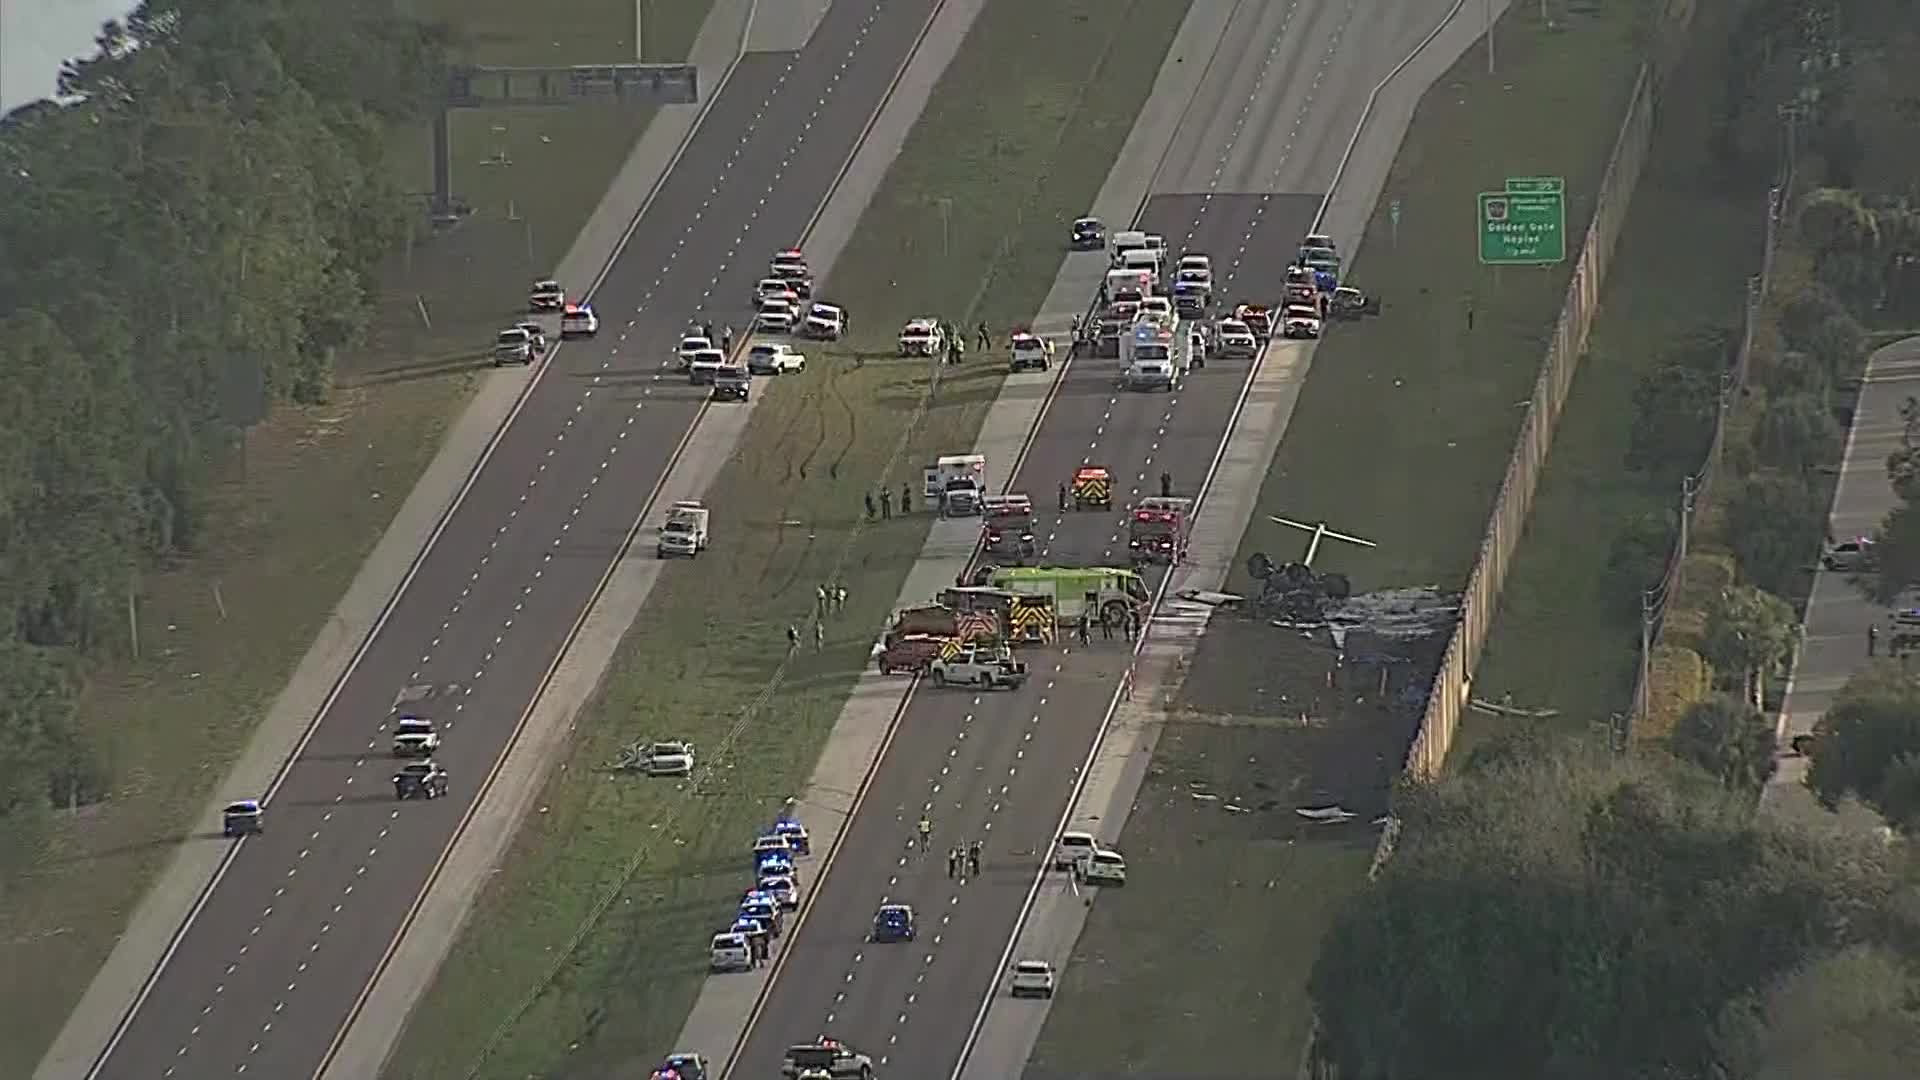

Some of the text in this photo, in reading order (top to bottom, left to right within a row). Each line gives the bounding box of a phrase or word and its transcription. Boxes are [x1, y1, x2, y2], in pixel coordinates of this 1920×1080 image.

[1488, 223, 1554, 232] Golden Gate
[1503, 234, 1539, 244] Naples
